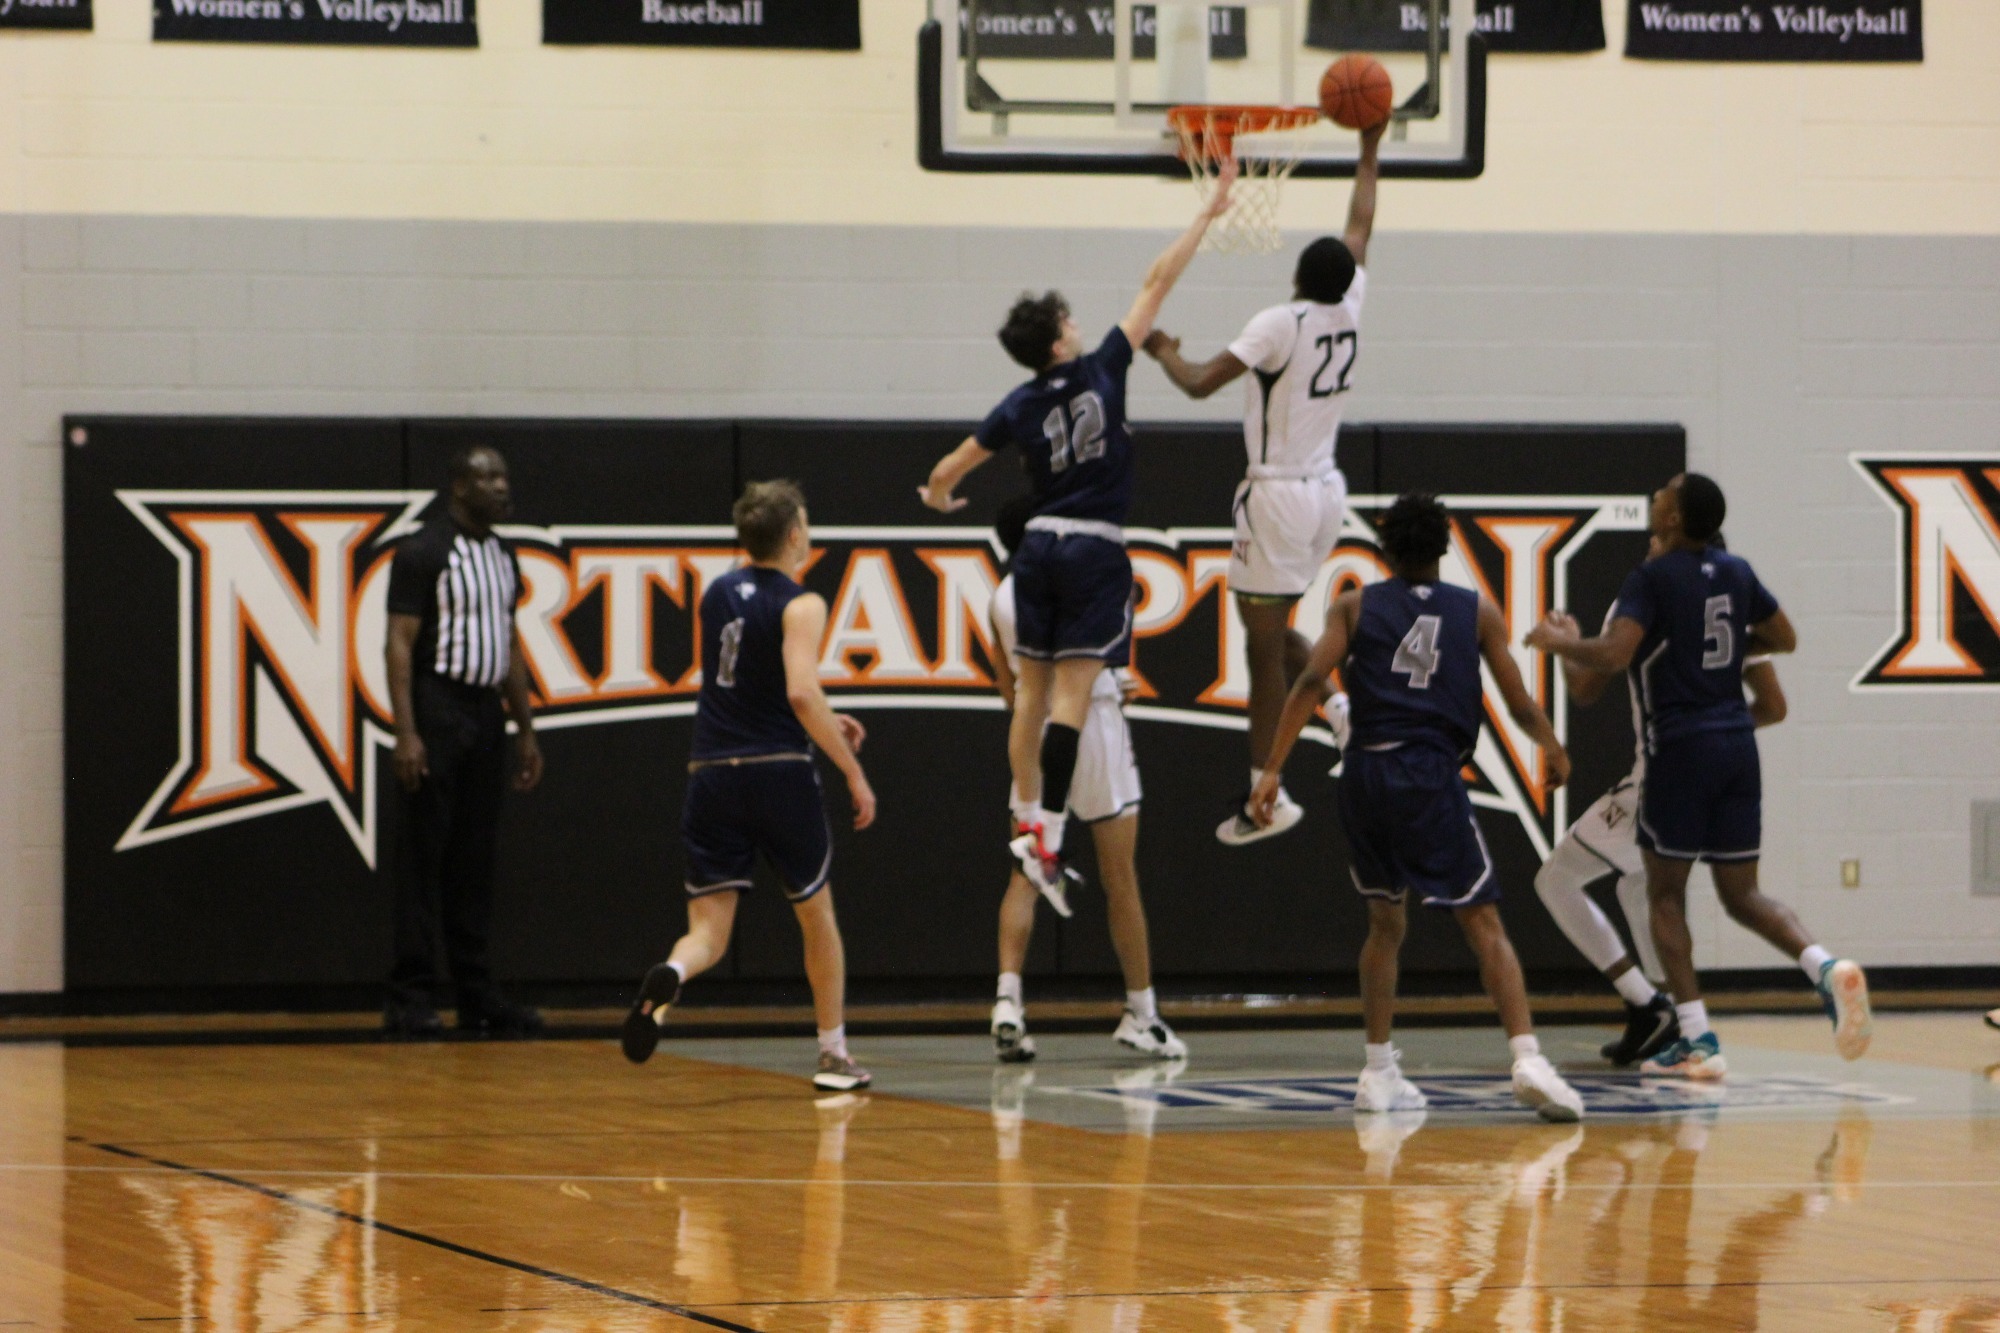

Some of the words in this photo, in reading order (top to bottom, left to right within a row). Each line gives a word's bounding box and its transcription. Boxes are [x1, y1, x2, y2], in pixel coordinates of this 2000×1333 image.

[171, 0, 304, 19] Womens
[318, 0, 464, 31] Volleyball
[641, 0, 763, 25] Baseball
[1087, 8, 1232, 36] Volell
[1401, 5, 1514, 32] Baall
[1640, 4, 1762, 32] Women's
[1771, 7, 1908, 43] Volleyball
[1307, 330, 1358, 400] 22
[1042, 390, 1107, 473] 12
[1390, 614, 1443, 690] 4
[1702, 594, 1733, 670] 5
[163, 506, 1582, 822] NRTAPTN
[1612, 504, 1639, 519] TM
